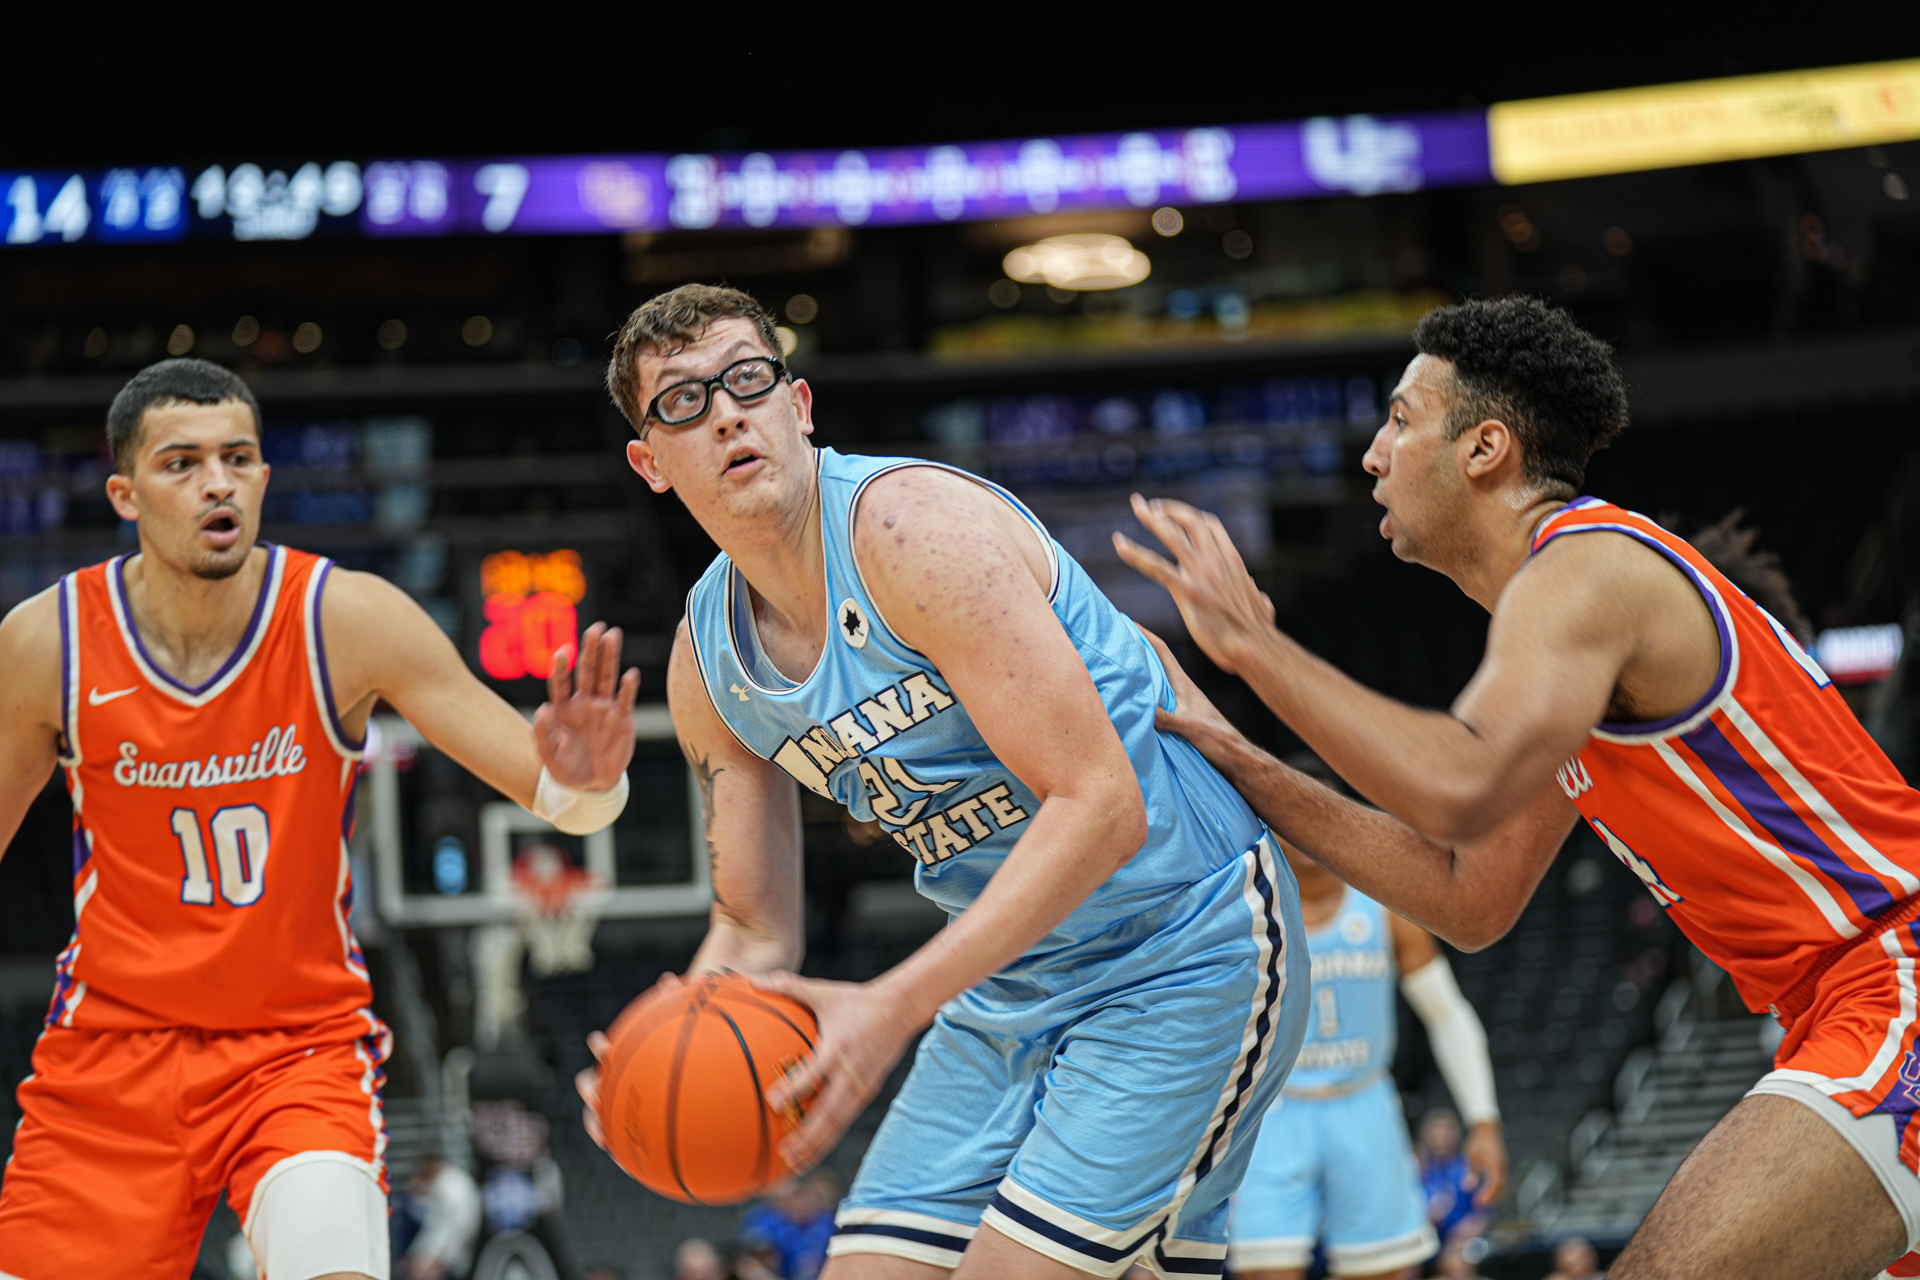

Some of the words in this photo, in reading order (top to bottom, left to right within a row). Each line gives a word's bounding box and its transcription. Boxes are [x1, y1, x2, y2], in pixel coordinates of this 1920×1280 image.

[5, 173, 92, 244] 14
[473, 162, 530, 233] 7
[113, 723, 307, 789] Evansville
[170, 802, 271, 908] 10
